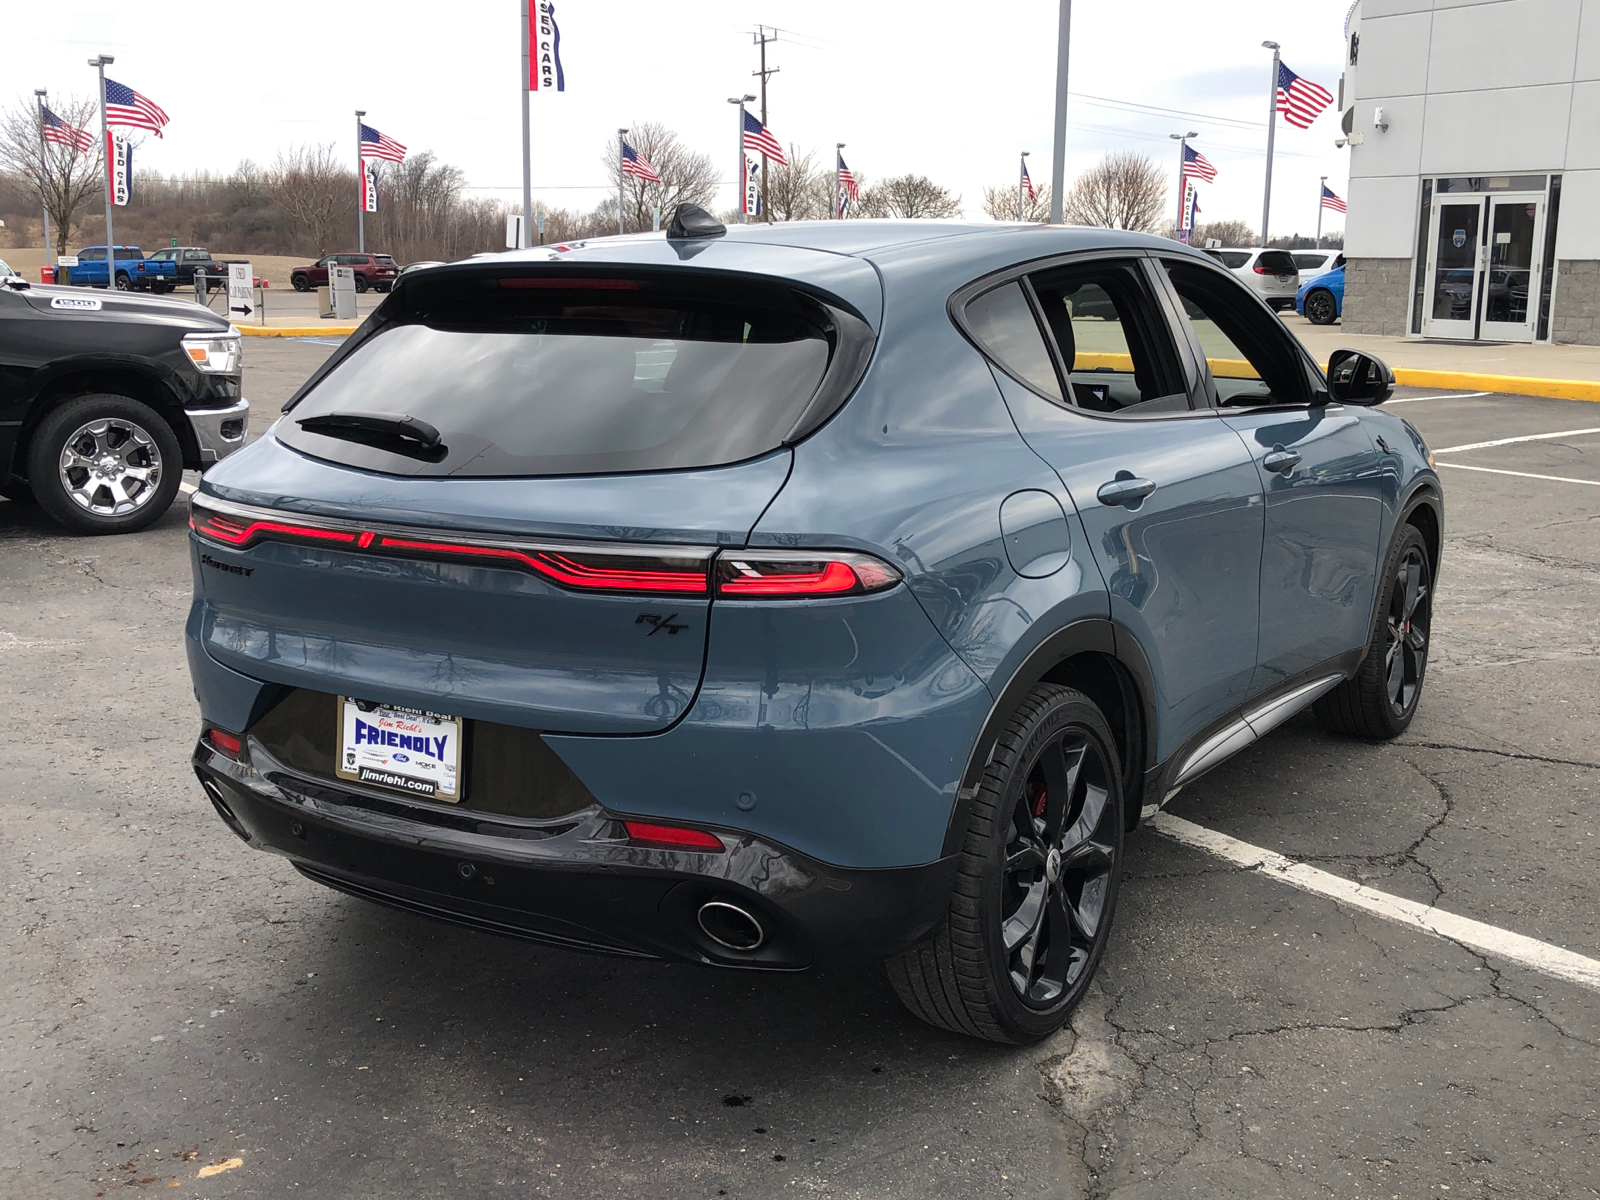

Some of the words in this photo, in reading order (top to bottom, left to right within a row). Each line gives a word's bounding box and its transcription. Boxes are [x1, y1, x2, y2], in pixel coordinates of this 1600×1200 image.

[541, 41, 552, 87] CARS
[116, 135, 125, 166] USED
[117, 171, 125, 202] CARS
[56, 299, 96, 307] 1500
[634, 612, 690, 637] R/T
[355, 716, 448, 763] FRIENDLY
[378, 717, 394, 728] Jim
[395, 720, 422, 734] Riehl's
[360, 768, 435, 793] jimriehl.com
